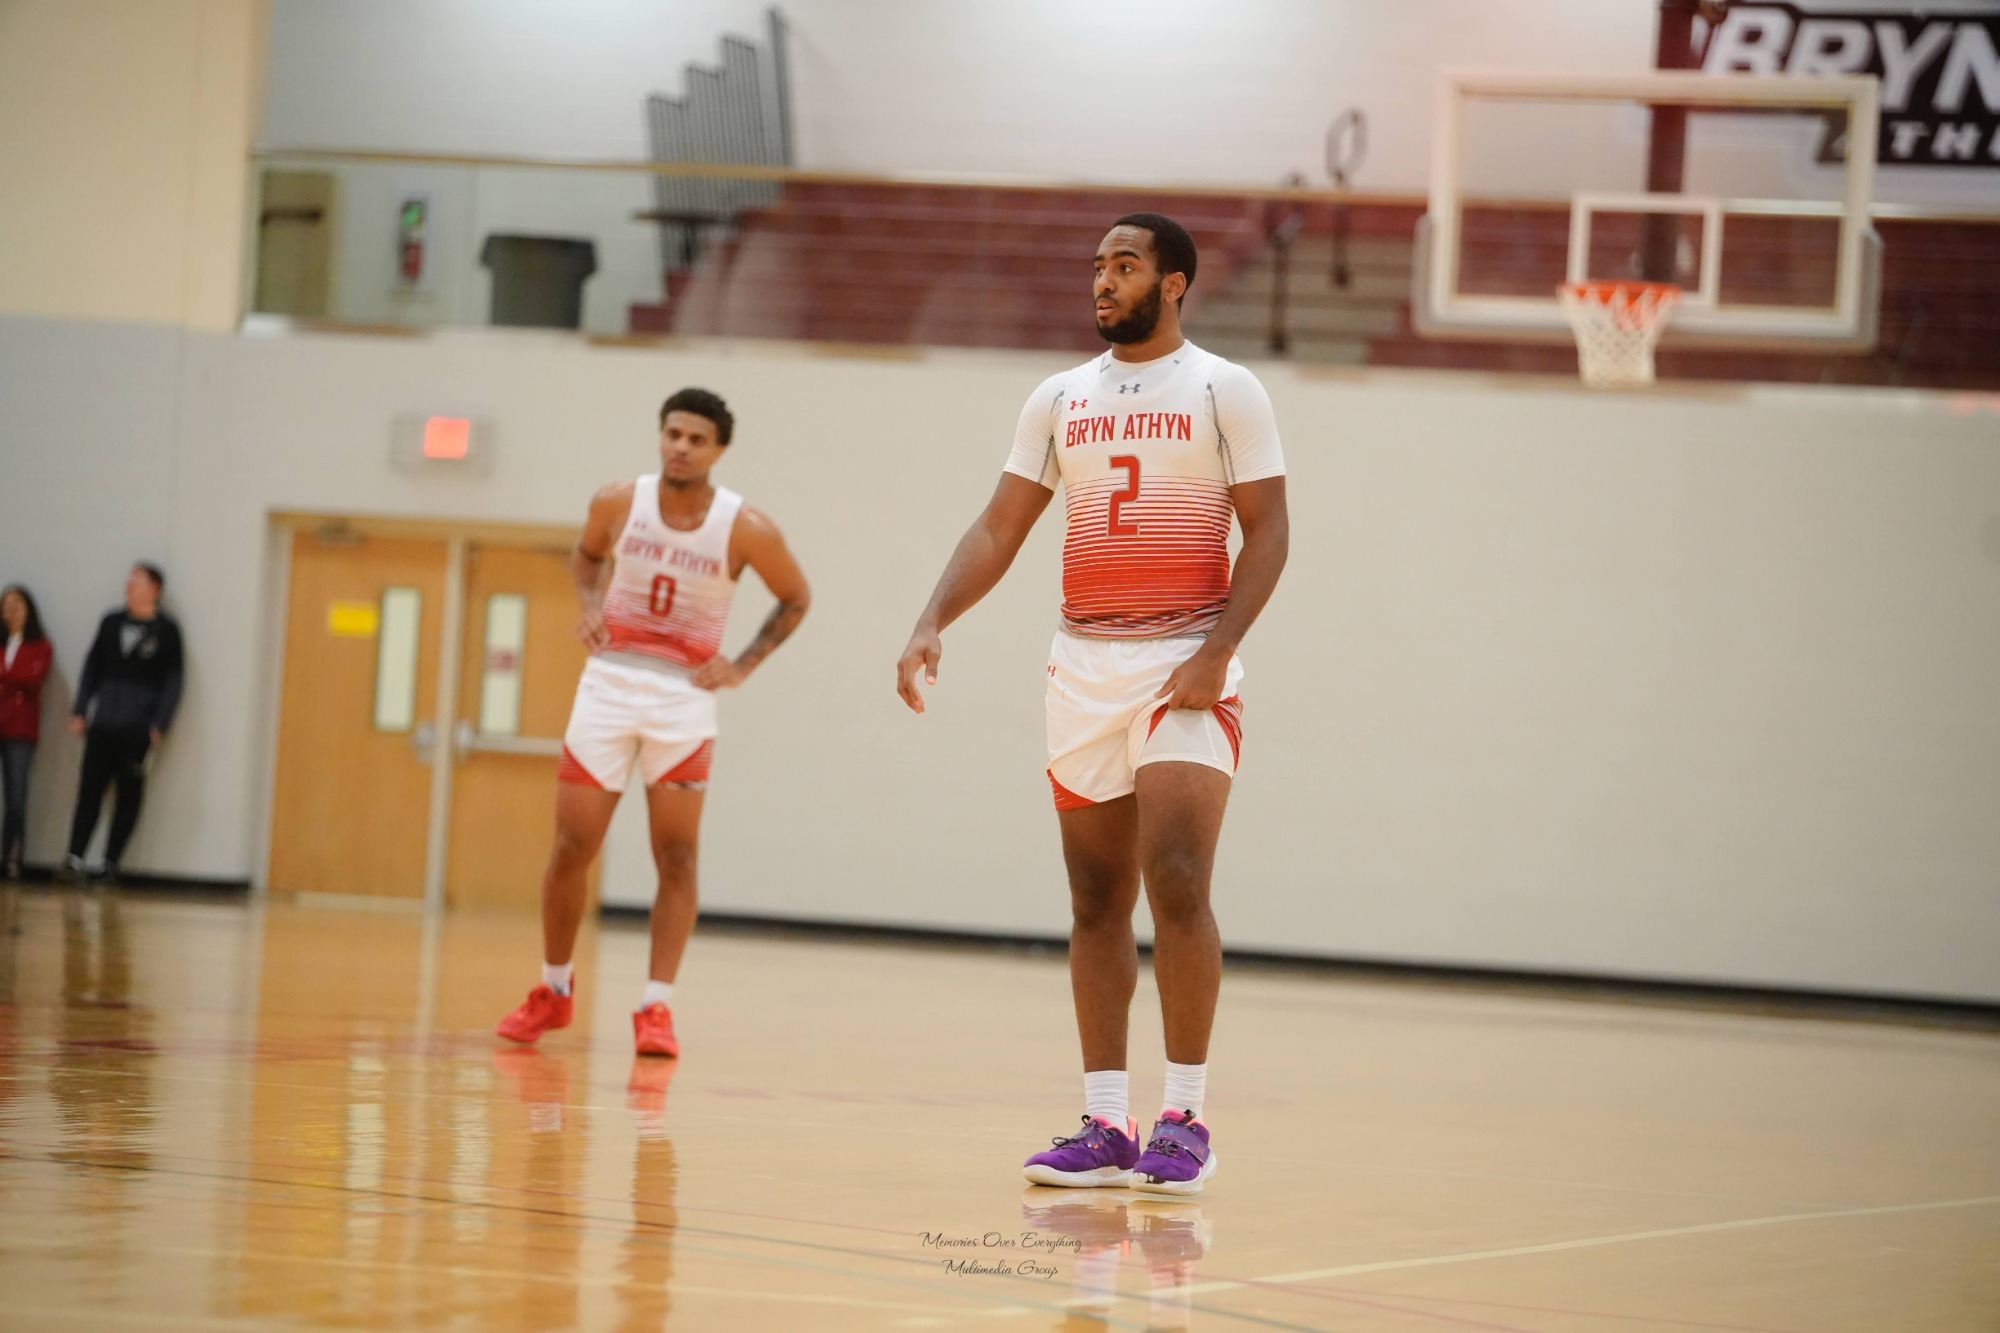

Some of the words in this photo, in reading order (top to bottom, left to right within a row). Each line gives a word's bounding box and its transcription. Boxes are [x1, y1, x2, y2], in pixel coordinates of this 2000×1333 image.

[1066, 415, 1116, 448] BRYN
[1123, 412, 1192, 441] ATHYN
[1106, 454, 1141, 538] 2
[623, 534, 665, 560] BRYN
[667, 547, 721, 577] ATHYN
[649, 573, 676, 618] 0
